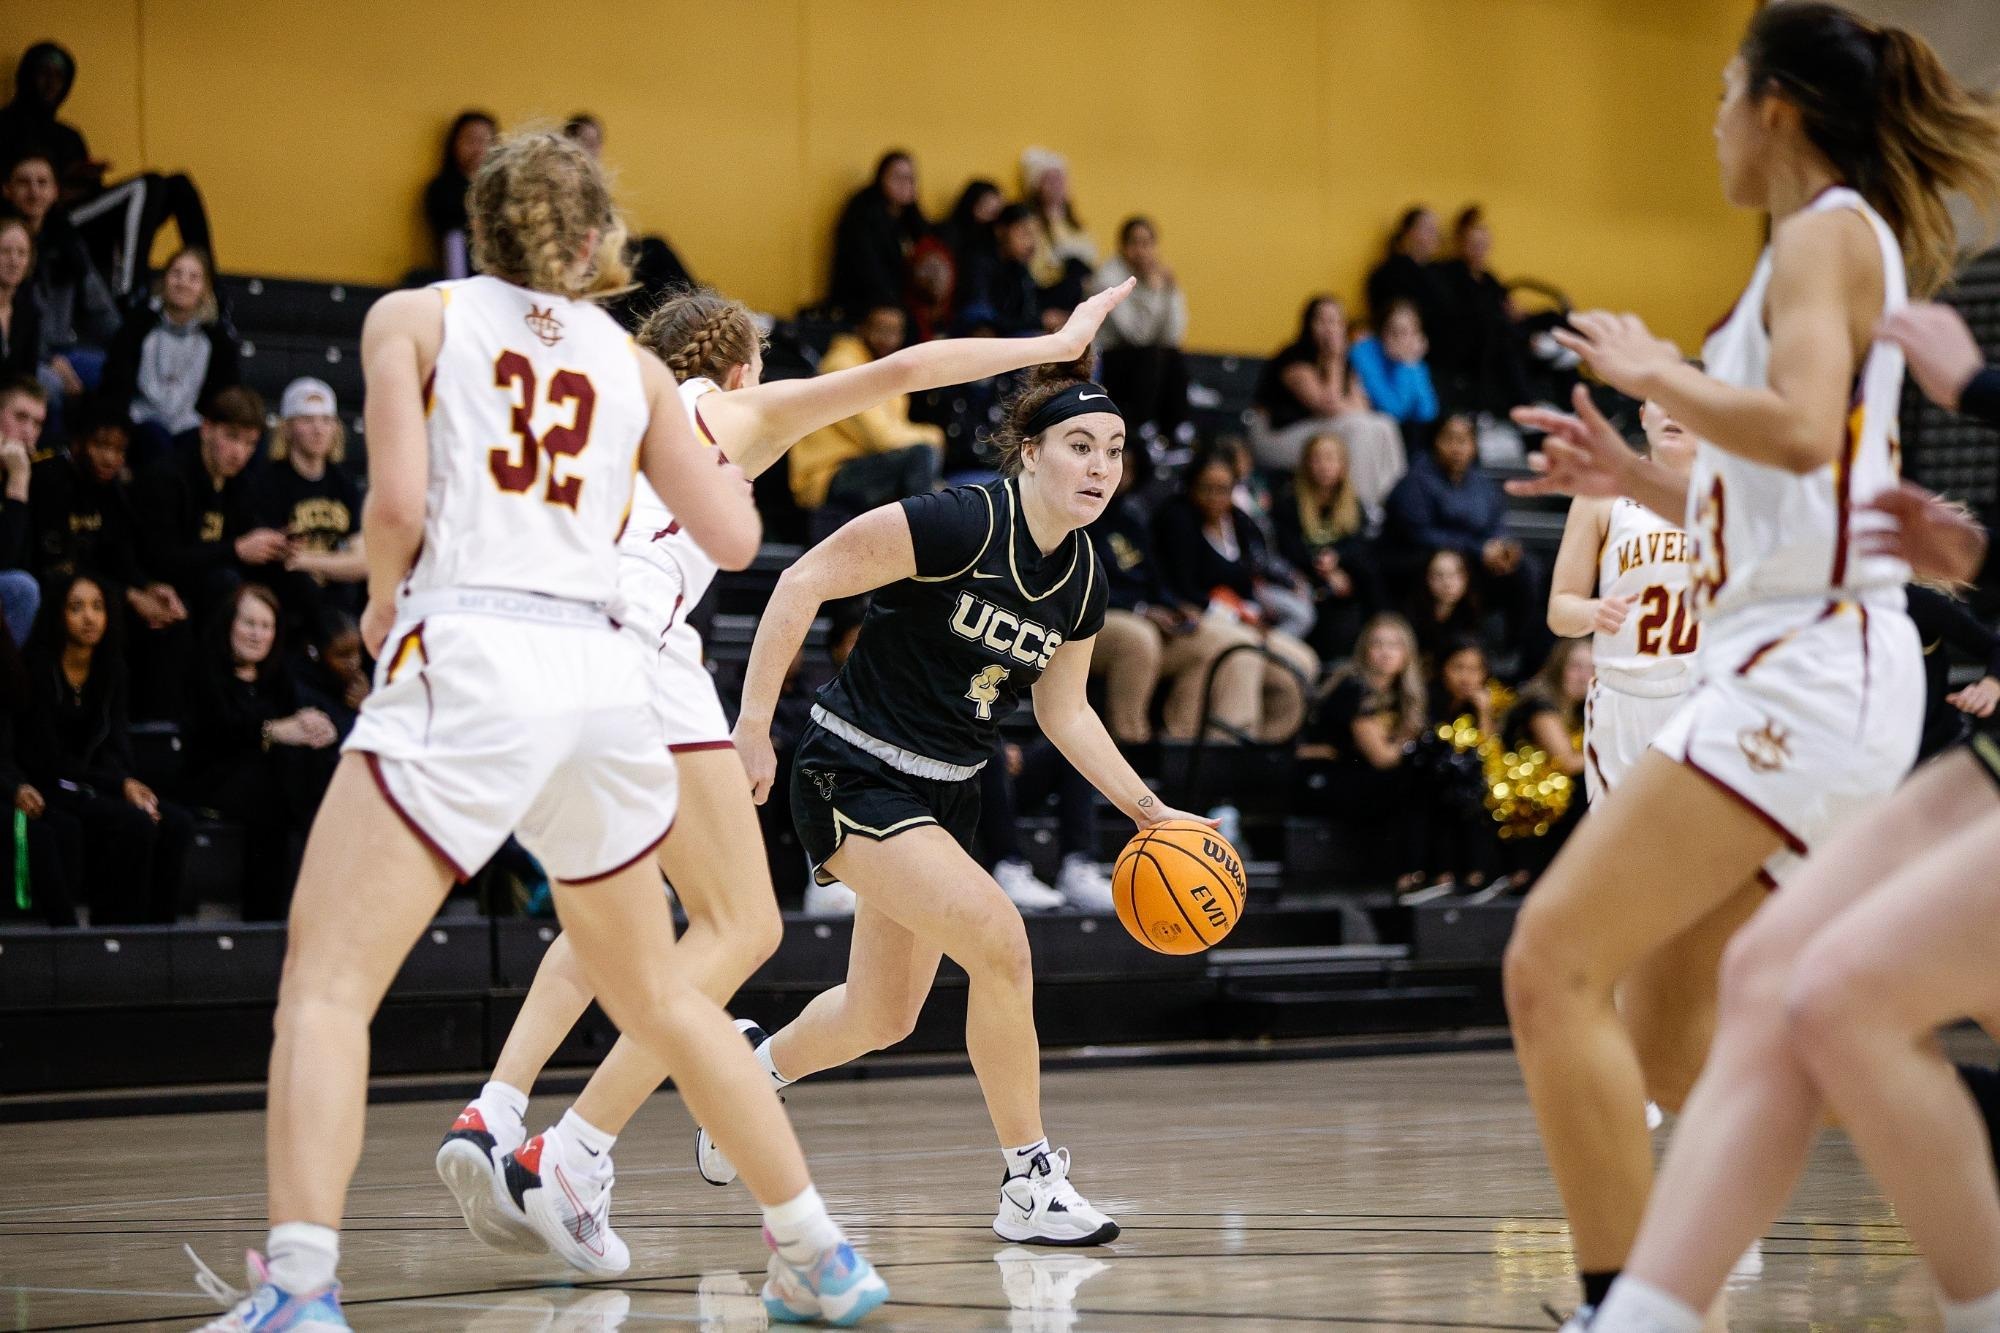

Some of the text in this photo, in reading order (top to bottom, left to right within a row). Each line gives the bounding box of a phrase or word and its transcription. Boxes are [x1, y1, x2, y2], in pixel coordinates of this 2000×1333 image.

[488, 350, 597, 515] 32
[948, 590, 1062, 671] UCCS
[963, 664, 1011, 721] 4
[1190, 885, 1227, 928] EVO
